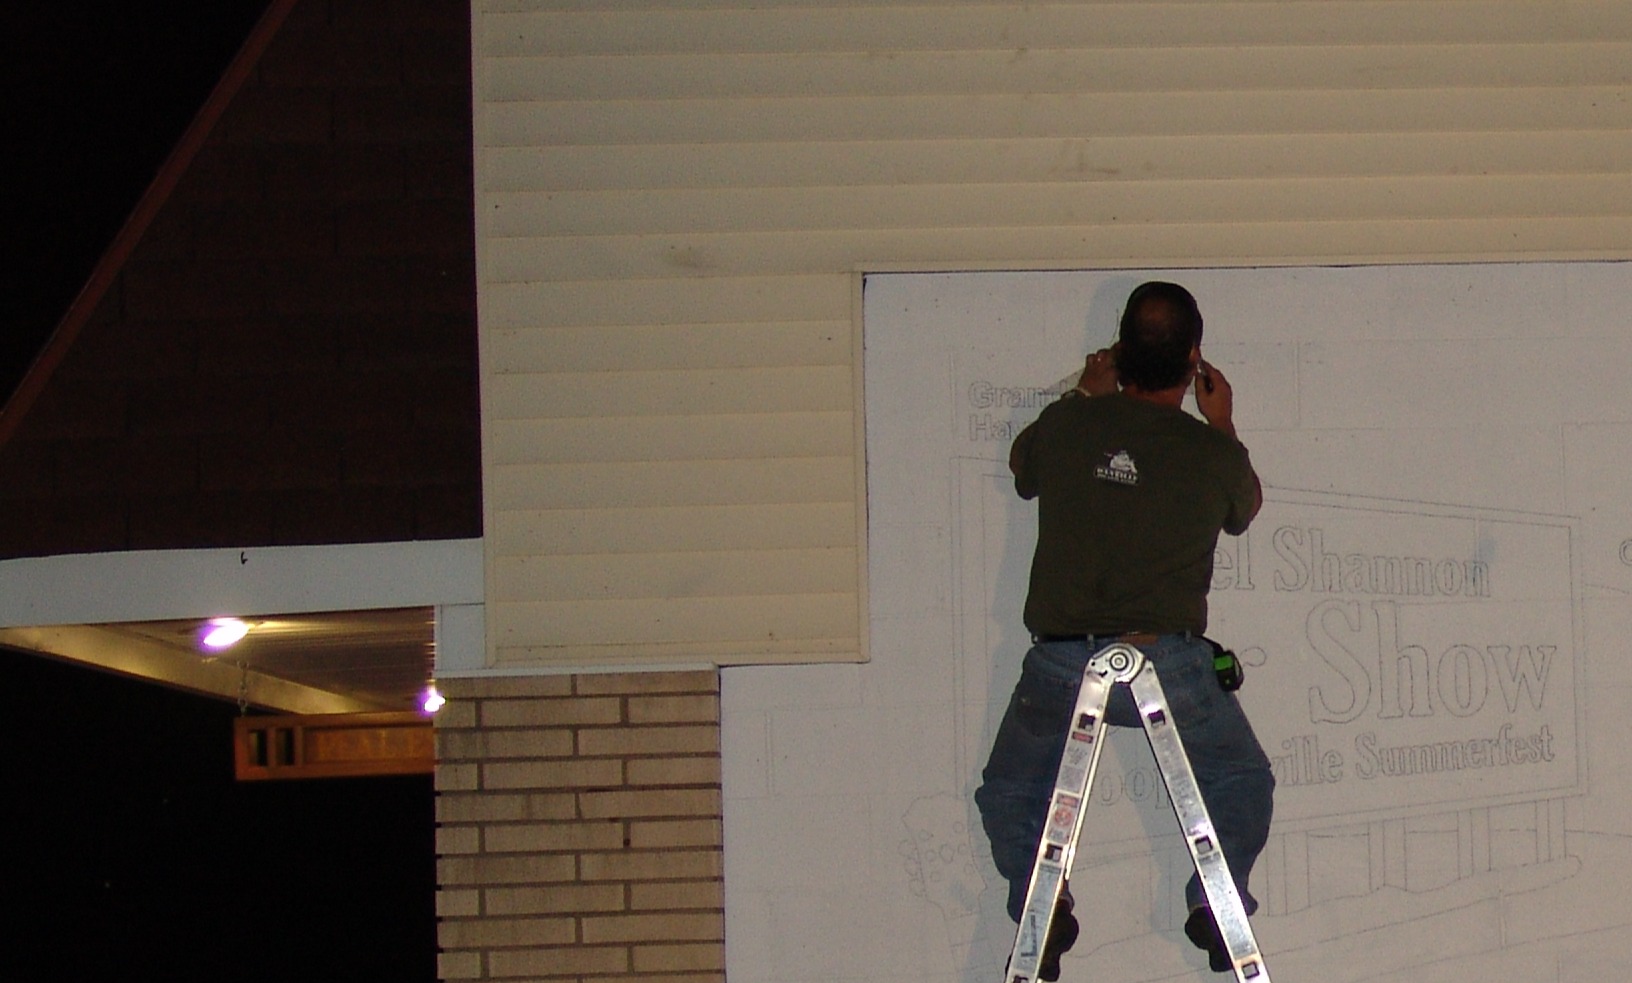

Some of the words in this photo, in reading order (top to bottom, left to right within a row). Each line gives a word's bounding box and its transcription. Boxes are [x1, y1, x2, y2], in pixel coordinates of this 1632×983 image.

[1212, 530, 1255, 590] el
[1272, 525, 1491, 598] Shannon
[1306, 599, 1557, 725] Show
[1355, 724, 1555, 780] Summerfest
